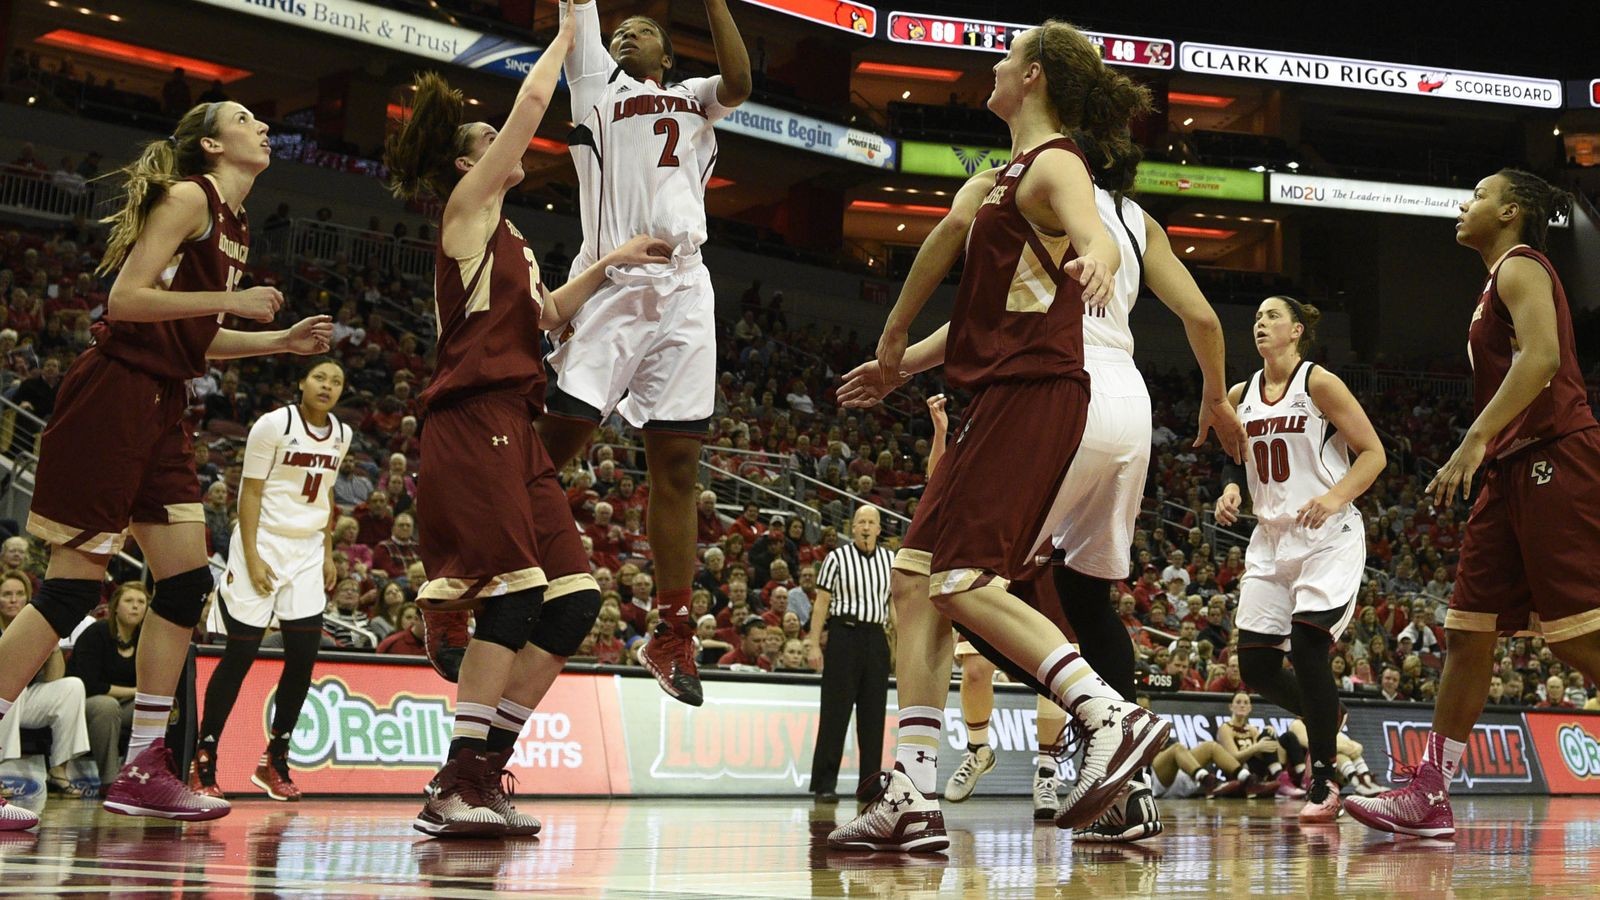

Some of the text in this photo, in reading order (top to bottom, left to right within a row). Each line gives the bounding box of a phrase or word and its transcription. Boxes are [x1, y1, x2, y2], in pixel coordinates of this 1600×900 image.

[245, 0, 460, 55] ards Bank & Trust
[968, 32, 976, 47] 1
[1112, 40, 1135, 61] 46
[1191, 49, 1553, 102] CLARK AND RIGGS SCOREBOARD
[653, 117, 680, 168] 2
[788, 118, 832, 148] Begin
[847, 137, 868, 148] POWER
[1280, 184, 1325, 202] MD2U
[1332, 188, 1347, 199] The
[1349, 190, 1380, 202] Leader
[1382, 192, 1391, 203] in
[1393, 193, 1449, 208] Home-Based
[1243, 415, 1308, 438] OUISVILLE
[1253, 438, 1290, 485] 00
[302, 470, 322, 503] 4
[1148, 675, 1172, 686] POSS
[518, 712, 571, 740] UTO
[510, 741, 582, 768] ARTS
